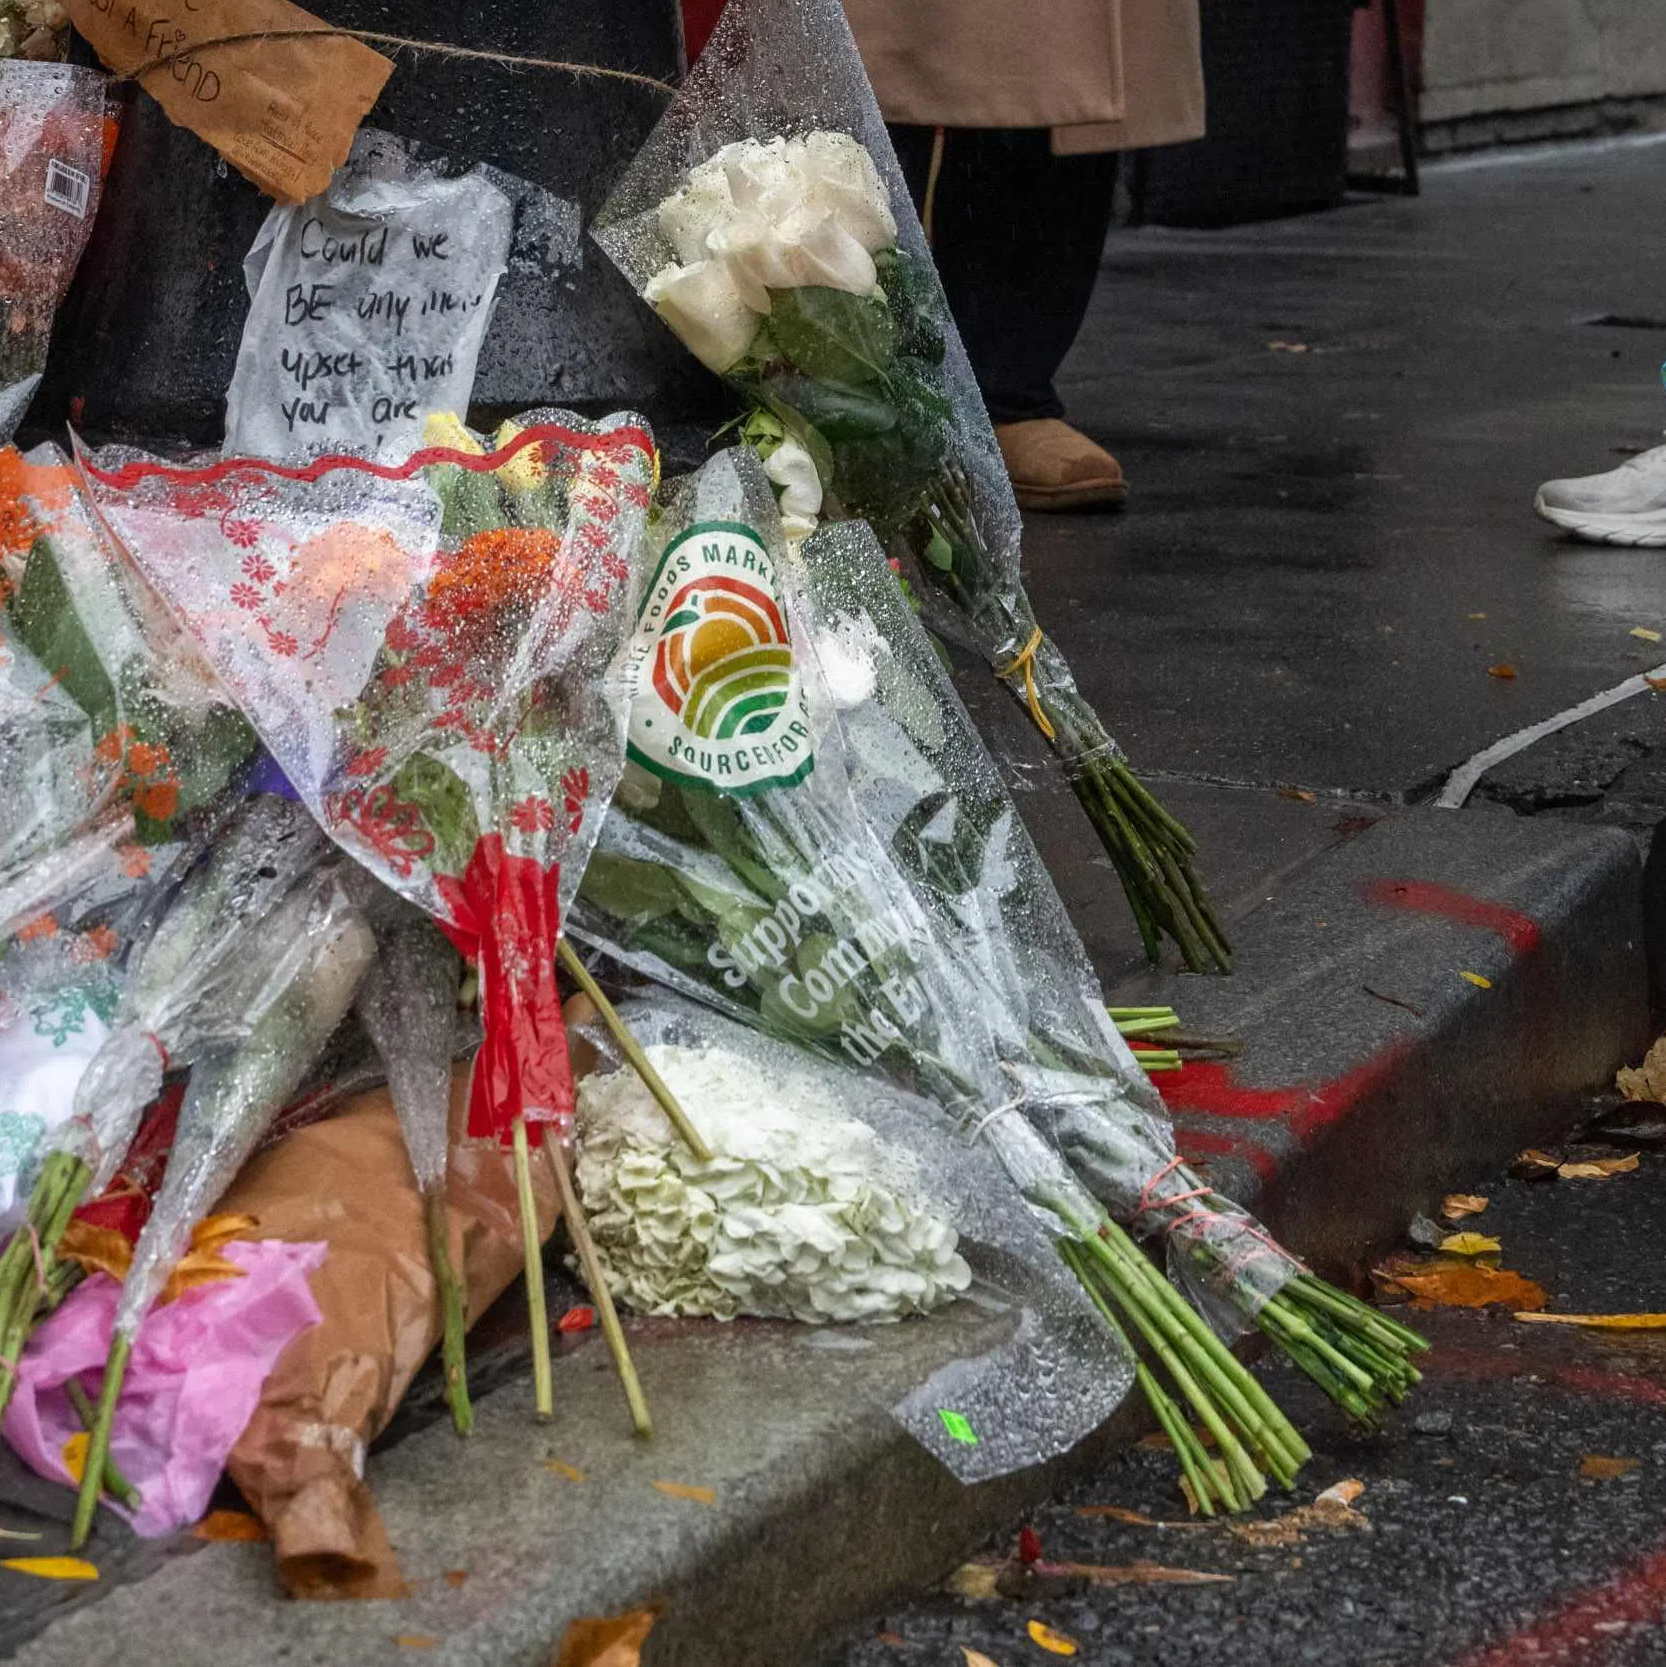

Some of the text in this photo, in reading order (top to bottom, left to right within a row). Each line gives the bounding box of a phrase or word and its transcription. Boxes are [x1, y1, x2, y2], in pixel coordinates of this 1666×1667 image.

[300, 217, 448, 265] Could we
[285, 284, 333, 326] BE
[358, 290, 411, 335] any
[282, 349, 362, 391] upset
[282, 397, 417, 431] you are
[644, 555, 691, 633] FOODS
[701, 544, 778, 587] MARK
[668, 735, 775, 774] SOURCE
